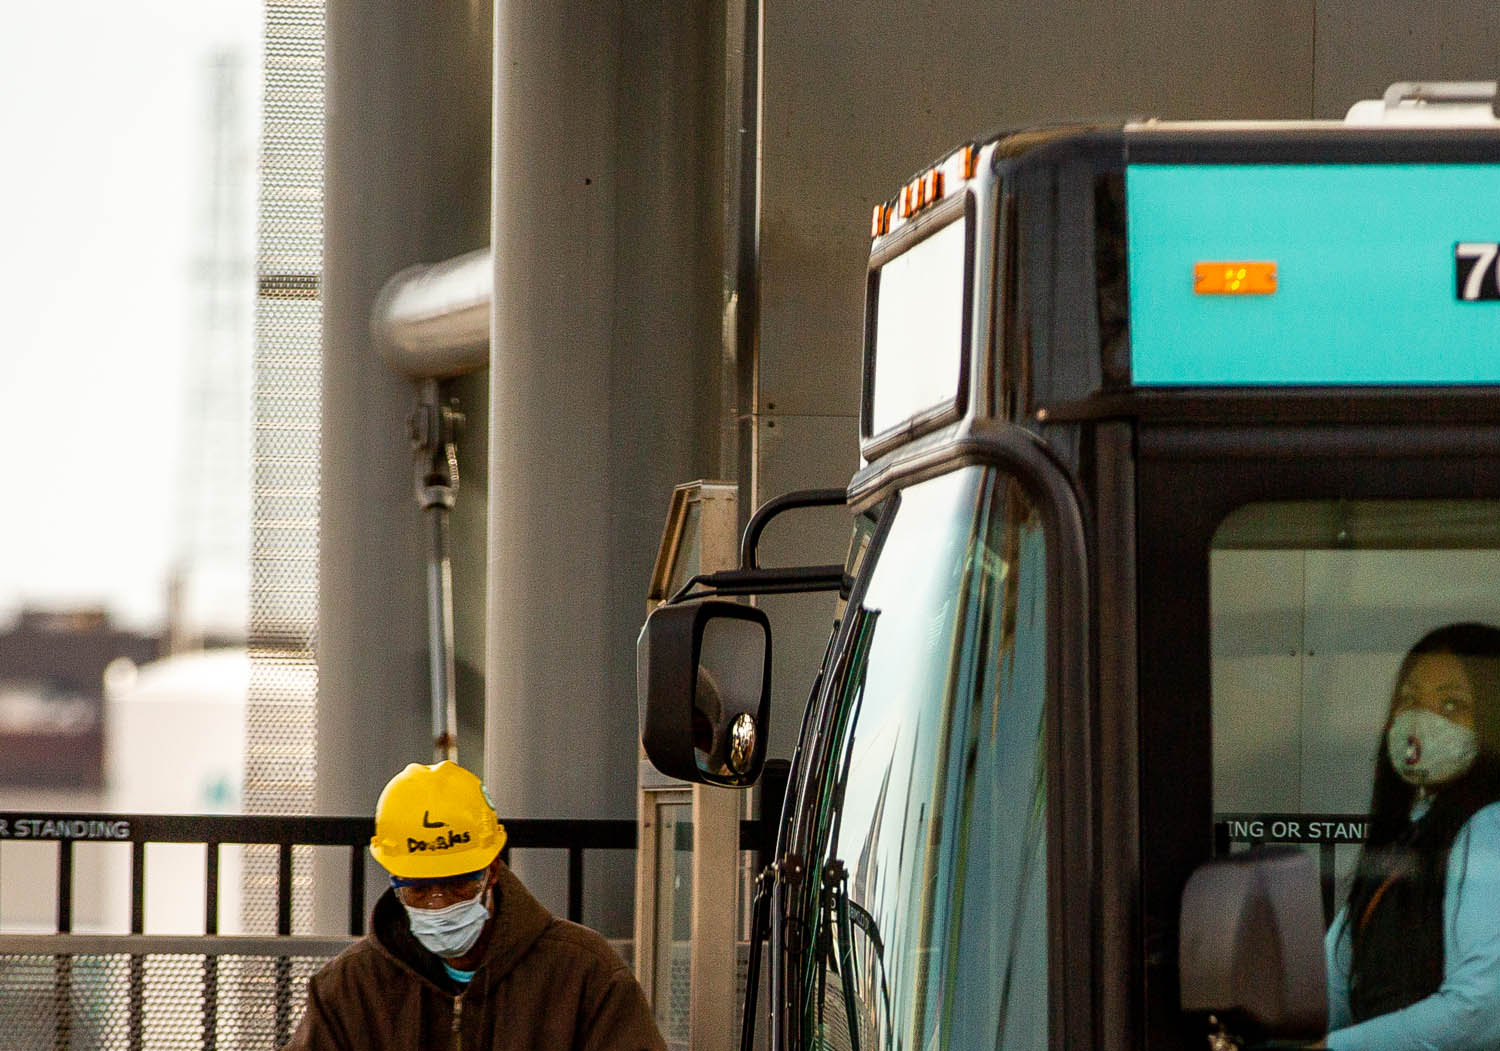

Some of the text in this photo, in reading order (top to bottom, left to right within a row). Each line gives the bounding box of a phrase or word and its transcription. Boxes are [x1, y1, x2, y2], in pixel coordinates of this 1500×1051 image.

[14, 819, 130, 838] STANDING
[1271, 822, 1301, 838] OR
[1308, 822, 1369, 838] STAN
